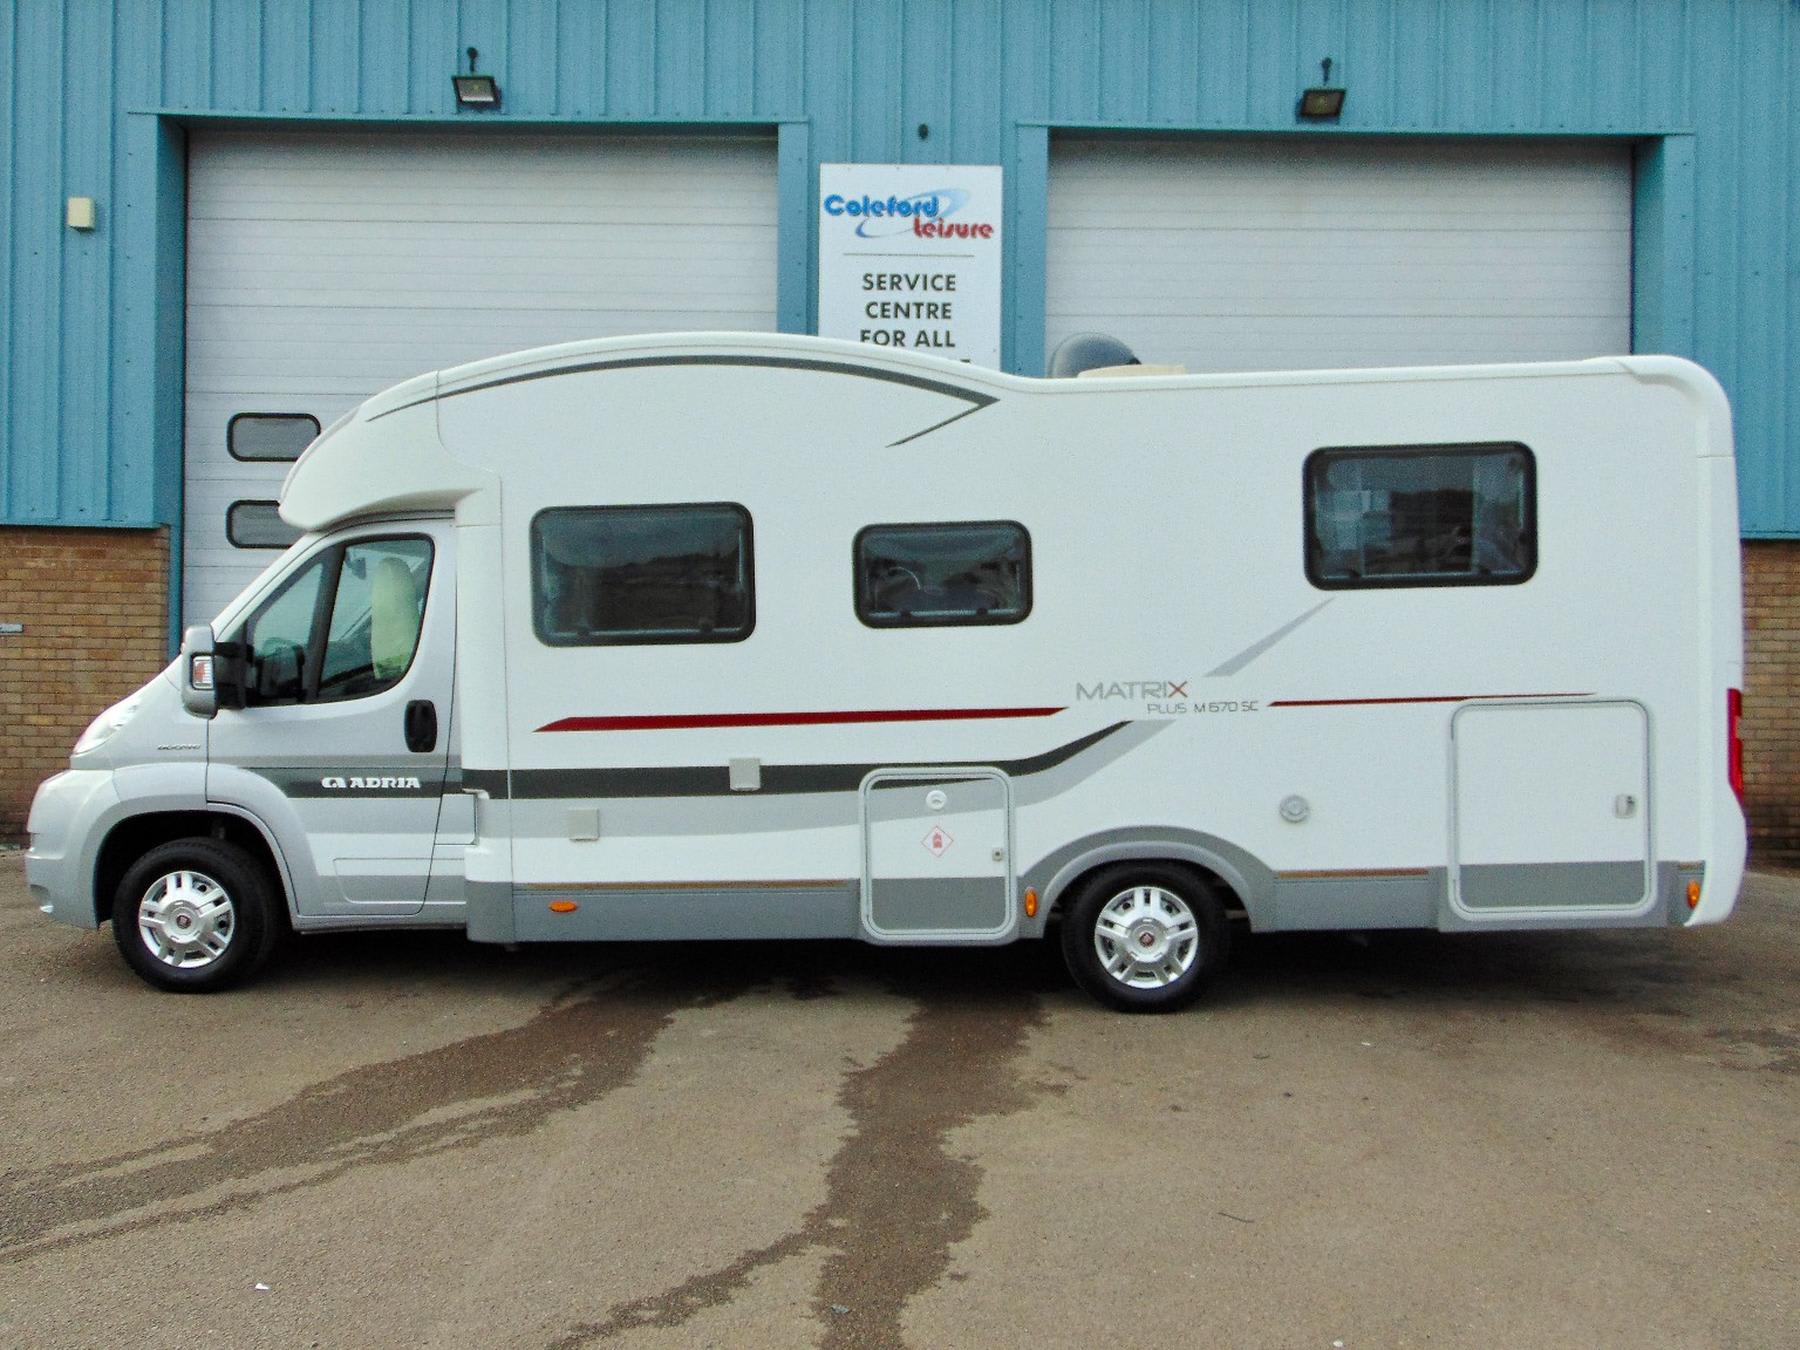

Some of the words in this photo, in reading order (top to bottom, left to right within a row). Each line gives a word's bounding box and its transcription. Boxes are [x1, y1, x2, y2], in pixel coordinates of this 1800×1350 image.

[823, 194, 940, 217] Coleford
[862, 273, 956, 292] SERVICE
[865, 302, 952, 320] CENTRE
[860, 329, 906, 347] FOR
[914, 330, 956, 348] ALL
[1076, 681, 1187, 700] MATRIX
[1147, 703, 1187, 715] PLUS
[349, 777, 421, 788] ADRIA
